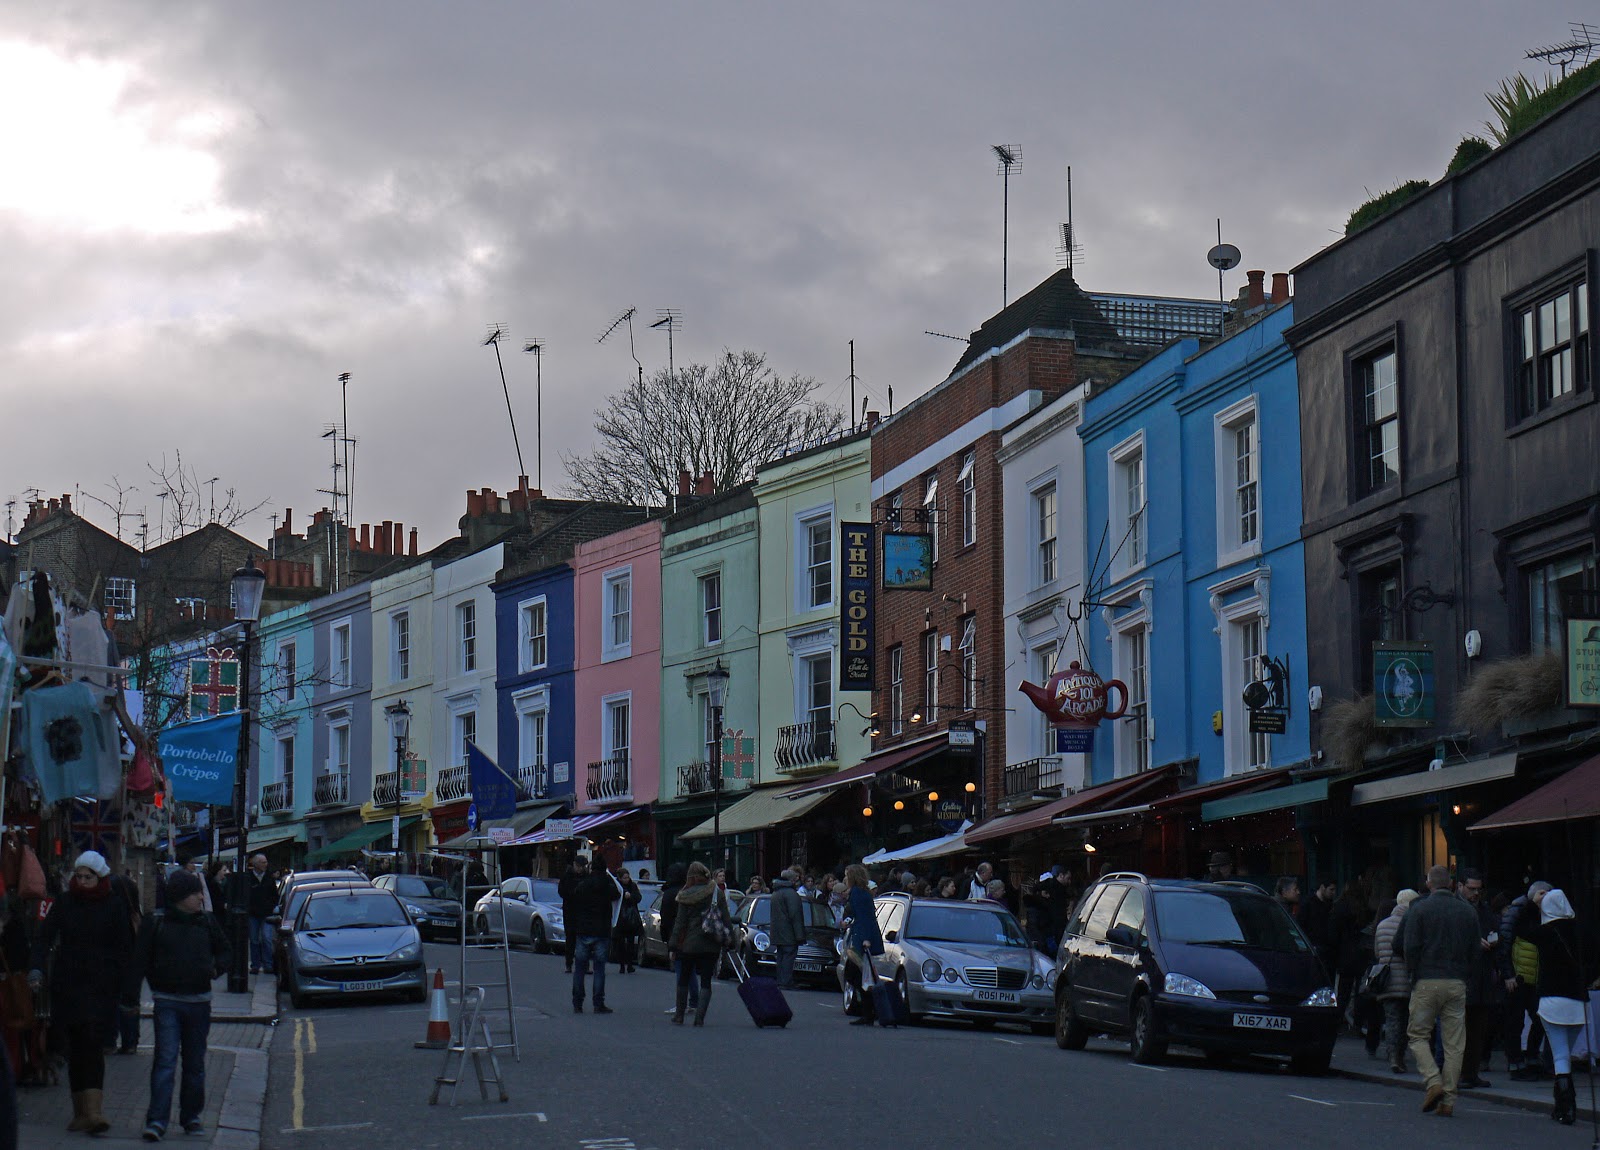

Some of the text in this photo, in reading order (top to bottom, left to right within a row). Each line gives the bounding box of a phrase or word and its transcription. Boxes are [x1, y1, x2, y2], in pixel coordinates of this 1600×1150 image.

[848, 532, 868, 578] THE
[848, 589, 868, 651] GOLD
[1080, 687, 1095, 700] 101
[1059, 696, 1105, 716] ARCADE
[161, 743, 234, 764] Portobello
[172, 763, 220, 781] Crêpes
[978, 990, 1016, 1001] RO51 PHA
[1237, 1015, 1288, 1029] X167 XAR
